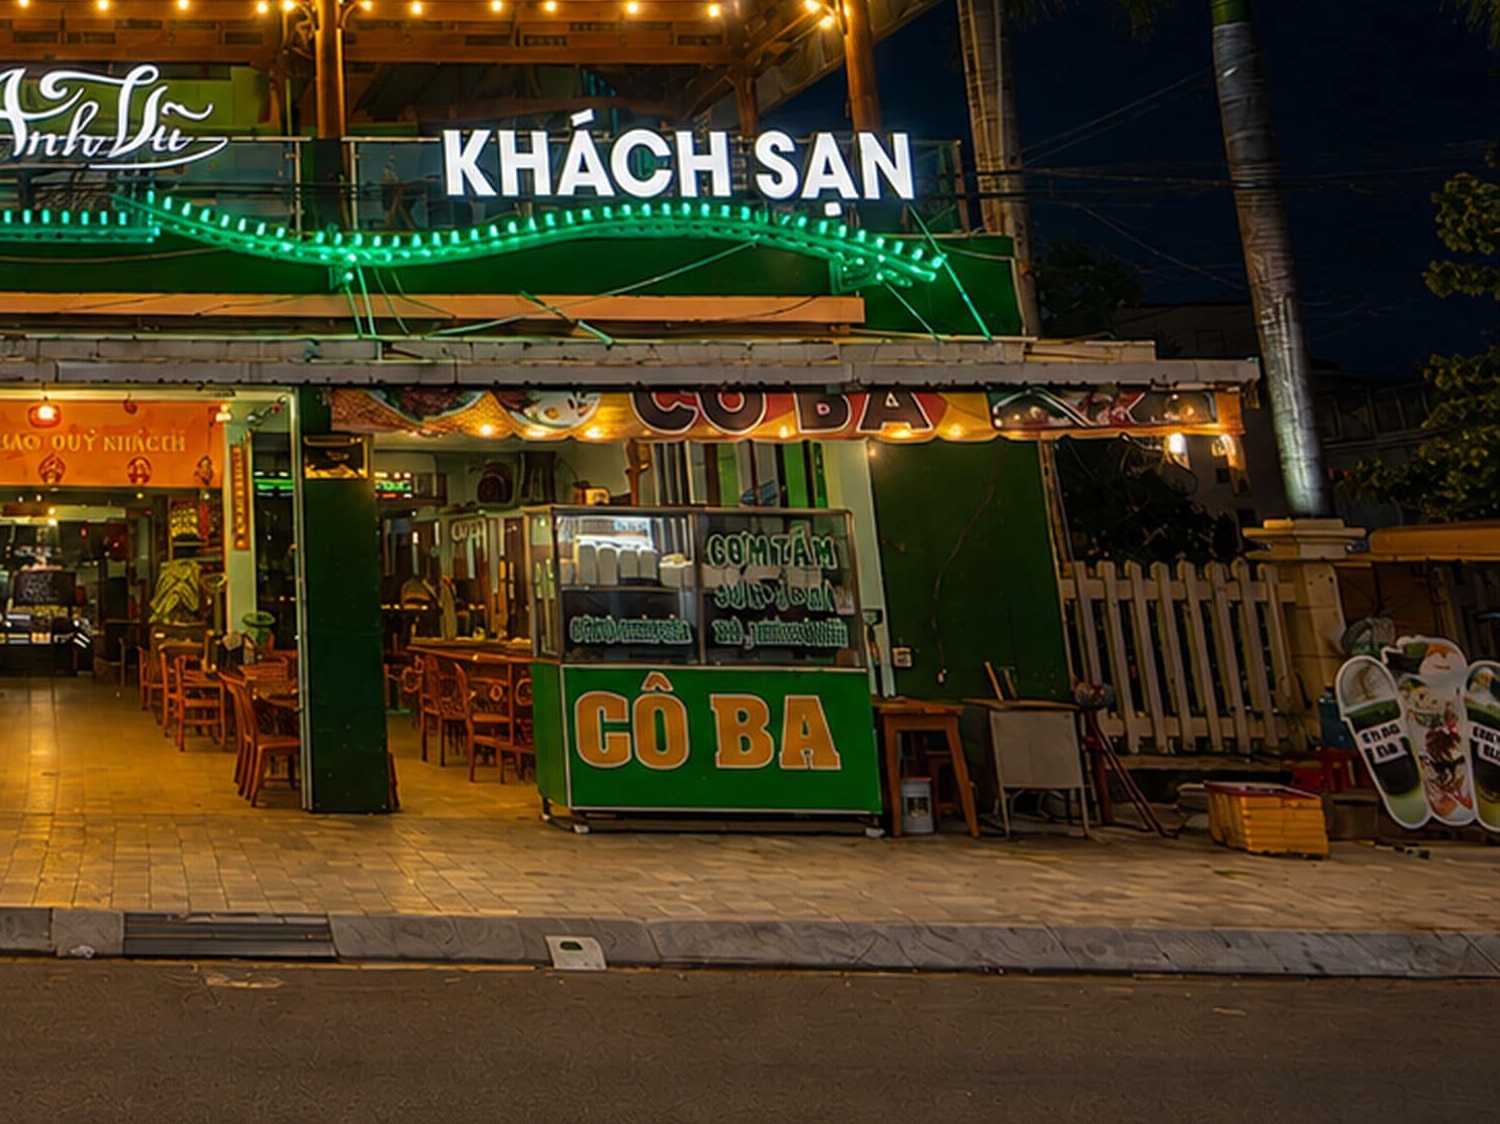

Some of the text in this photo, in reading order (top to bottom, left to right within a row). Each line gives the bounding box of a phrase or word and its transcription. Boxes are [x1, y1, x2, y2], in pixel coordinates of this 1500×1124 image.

[442, 108, 915, 217] KHÁCH SẠN
[573, 671, 842, 771] CÔ BA
